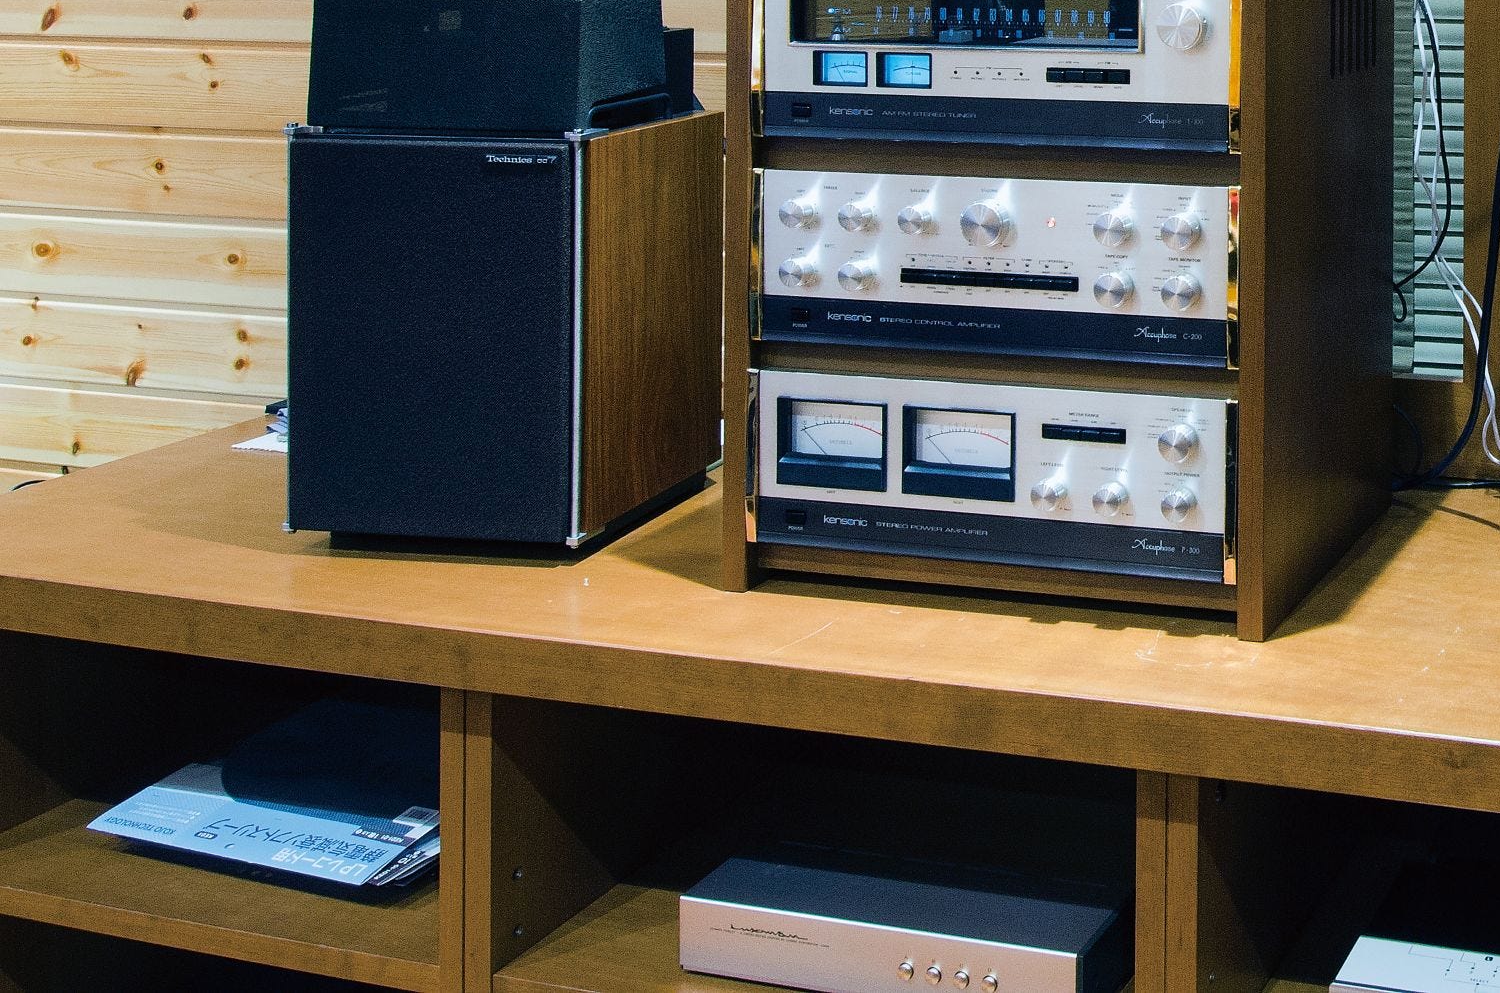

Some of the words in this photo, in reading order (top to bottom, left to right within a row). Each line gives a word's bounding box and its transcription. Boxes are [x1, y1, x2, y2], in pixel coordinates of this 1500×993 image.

[829, 106, 873, 116] kensonic
[486, 154, 533, 164] Technics
[827, 311, 872, 323] kensonic
[879, 316, 913, 324] STEREO
[914, 318, 954, 327] CONTROL
[957, 321, 1001, 329] AMPLIFIER
[1133, 326, 1177, 343] Accuphase
[1182, 333, 1203, 341] C-200
[823, 514, 868, 527] kensonic
[876, 521, 910, 530] STEREO
[910, 524, 943, 533] POWER
[945, 527, 988, 536] AMPLIFIER
[1131, 538, 1176, 556] Accuphase
[1181, 546, 1200, 555] P-300
[104, 816, 153, 833] TECHNOLOGY
[271, 847, 370, 878] LPレコード用
